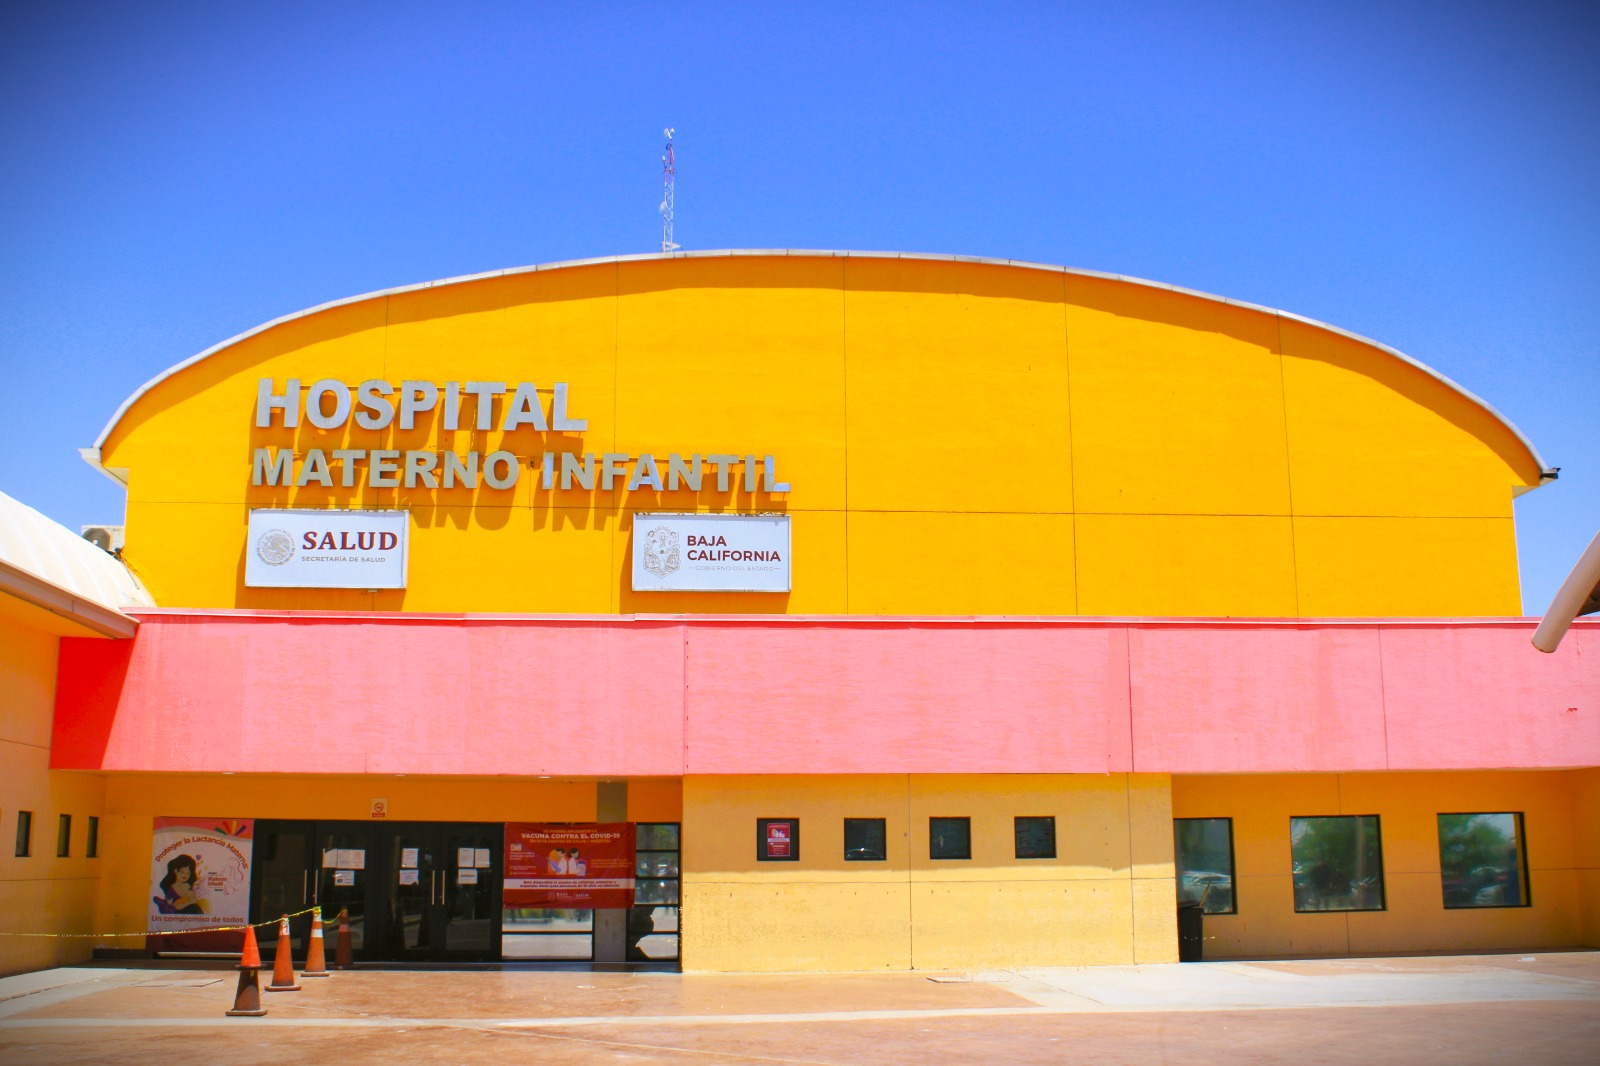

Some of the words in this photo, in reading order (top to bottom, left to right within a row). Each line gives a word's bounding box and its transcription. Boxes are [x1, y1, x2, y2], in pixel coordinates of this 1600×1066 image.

[255, 377, 588, 432] HOSPITAL
[251, 447, 520, 489] MATERNO
[542, 452, 791, 493] INFANTIL
[302, 531, 398, 551] SALUD
[687, 535, 727, 547] BAJA
[687, 550, 781, 562] CALIFORNIA
[155, 840, 183, 863] Proteger
[192, 836, 226, 847] Lactancia
[163, 915, 210, 923] compromiso
